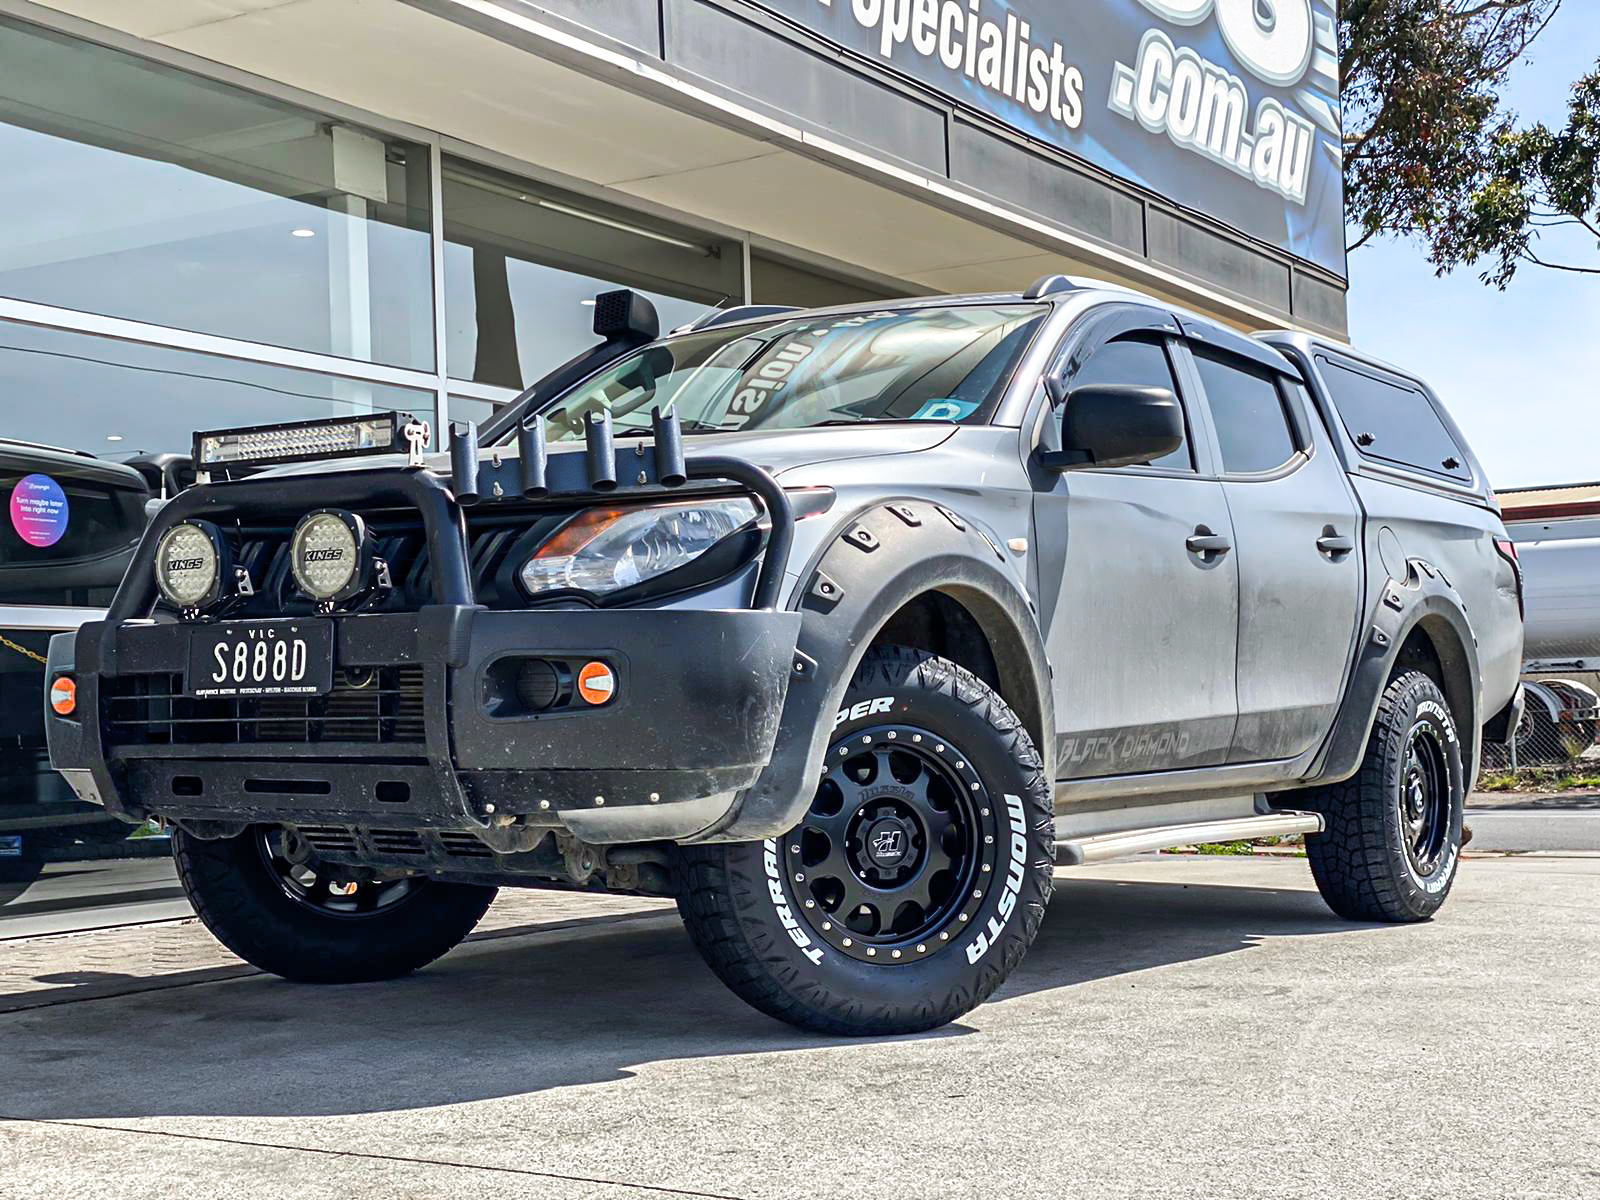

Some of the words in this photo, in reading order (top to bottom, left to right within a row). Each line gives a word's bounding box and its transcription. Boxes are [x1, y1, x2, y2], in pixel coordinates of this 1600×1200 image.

[1112, 34, 1312, 202] .com.au
[168, 559, 203, 571] KINGS
[305, 550, 343, 561] KINGS
[248, 629, 275, 639] VIC
[212, 639, 307, 683] S888D
[1056, 730, 1122, 769] BLACK
[1119, 731, 1191, 761] DIAMOND
[965, 793, 1027, 966] MONSTA
[763, 836, 825, 966] TERRAI
